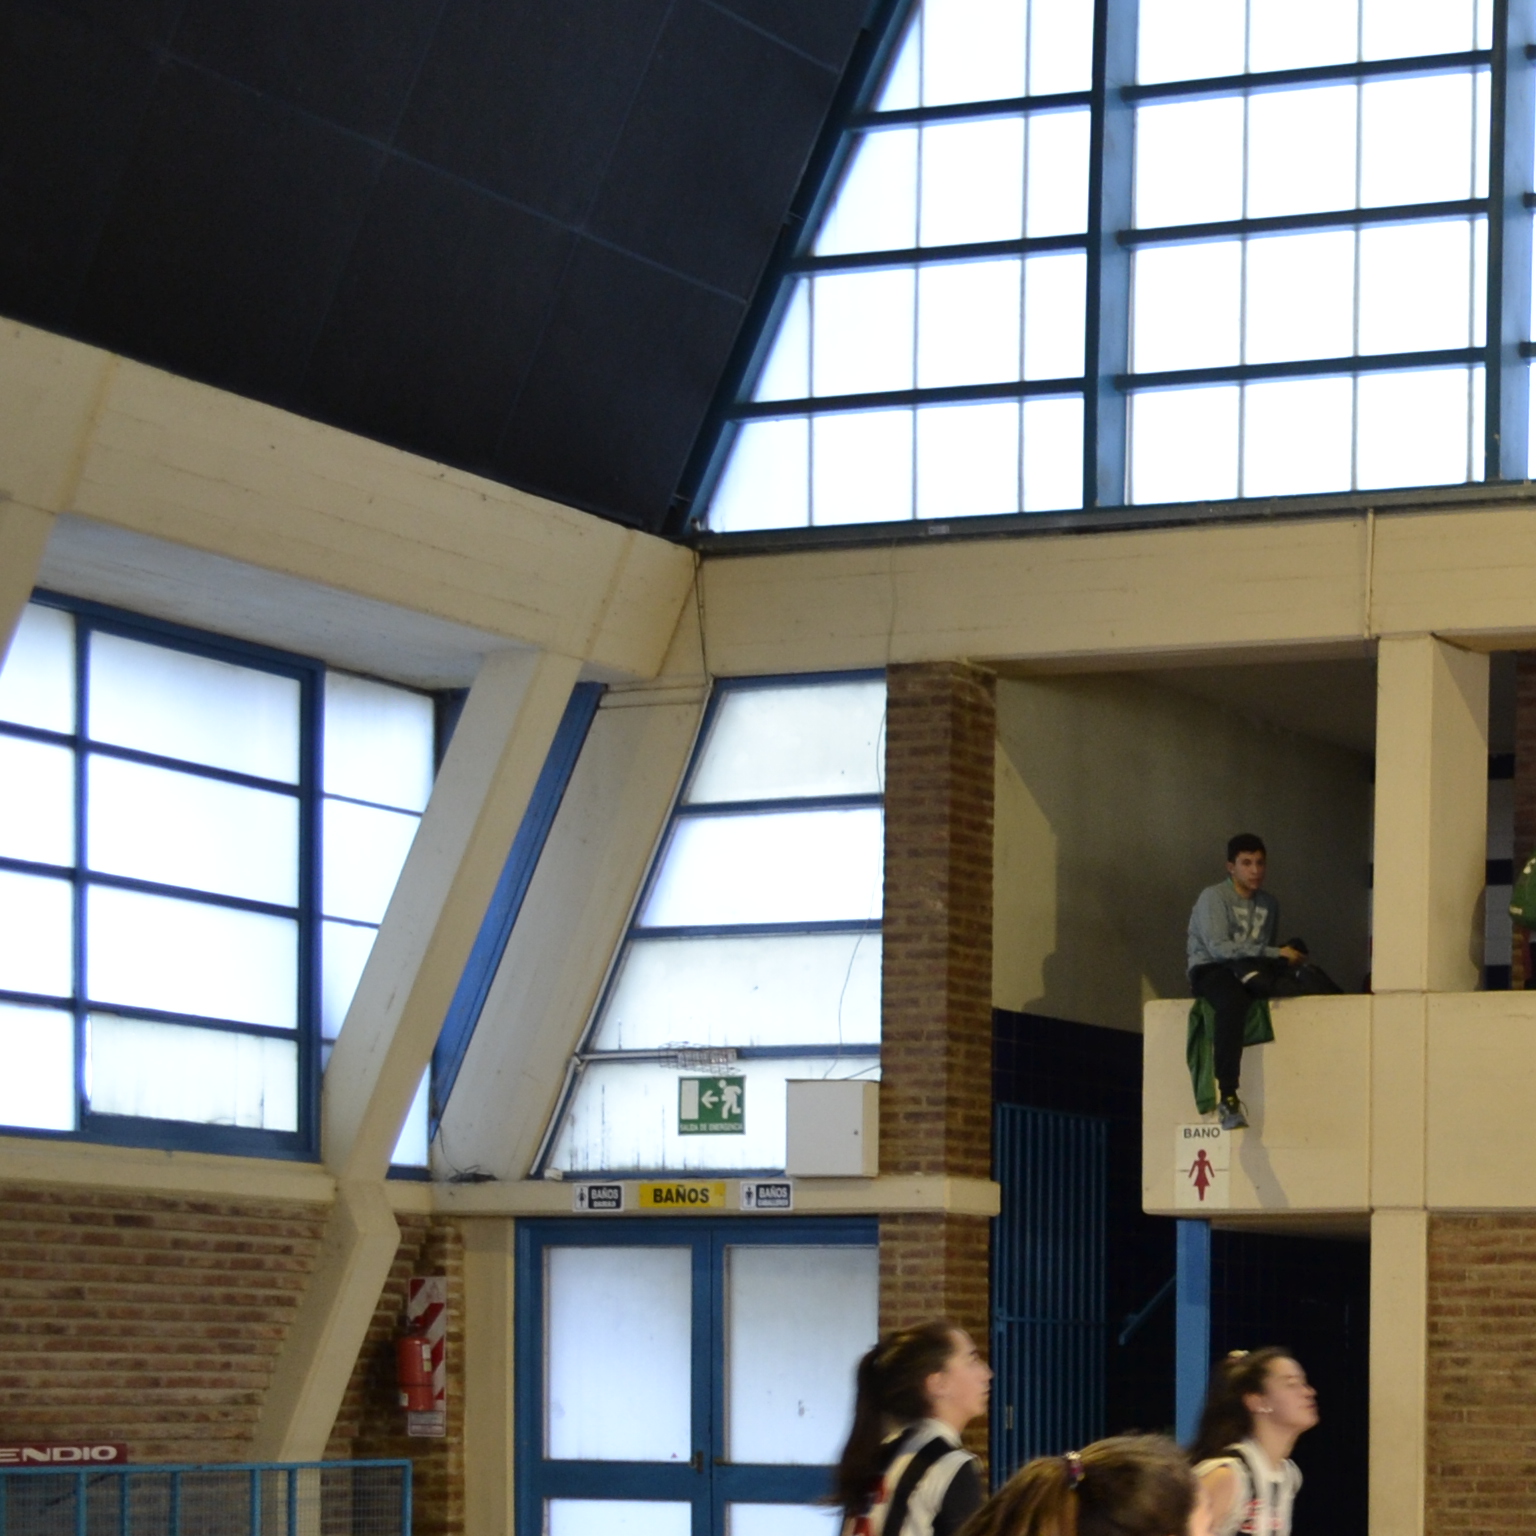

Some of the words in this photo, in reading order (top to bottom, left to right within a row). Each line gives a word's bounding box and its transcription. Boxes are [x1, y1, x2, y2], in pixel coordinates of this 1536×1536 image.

[591, 1187, 619, 1200] BAÑOS
[652, 1185, 710, 1204] BAÑOS
[759, 1186, 788, 1199] BAÑOS
